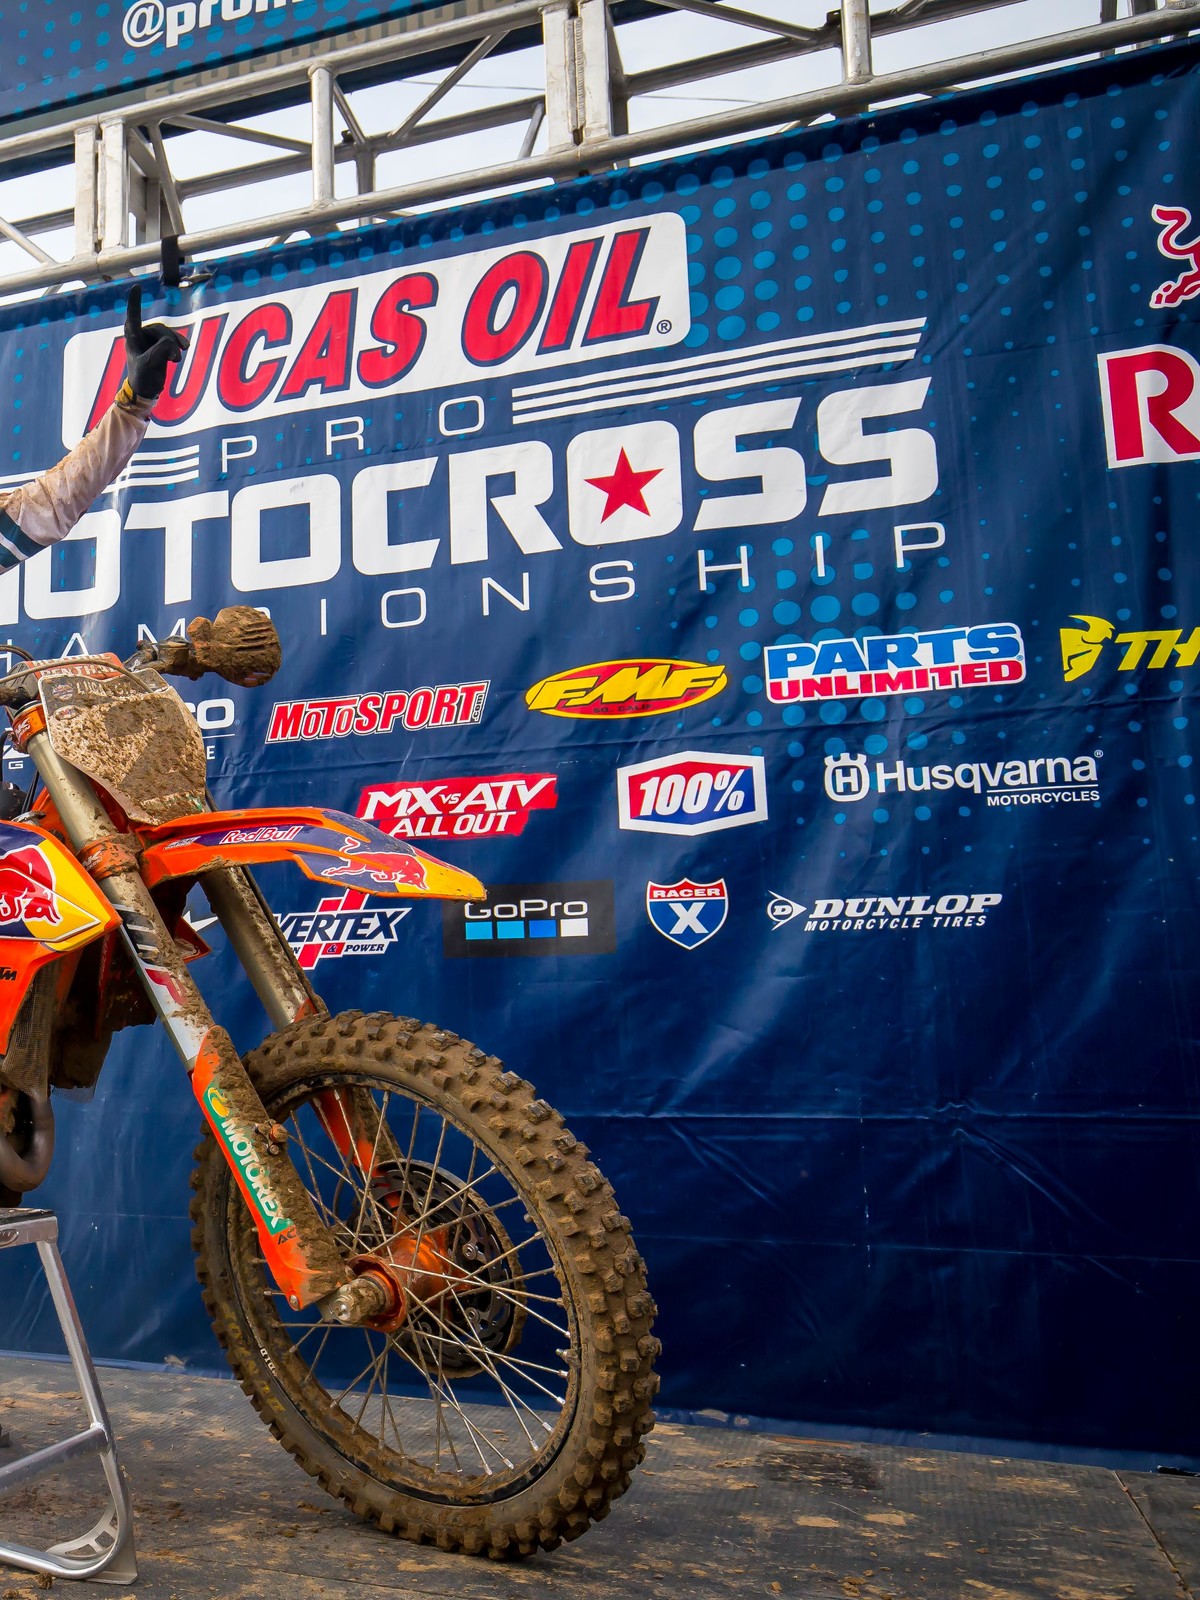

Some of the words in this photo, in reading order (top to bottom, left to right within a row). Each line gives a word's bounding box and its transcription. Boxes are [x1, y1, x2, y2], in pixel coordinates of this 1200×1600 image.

[122, 0, 305, 48] @pro
[460, 227, 664, 368] OIL
[221, 394, 486, 474] PRO
[766, 623, 1023, 680] PARTS
[528, 664, 725, 711] FMF
[768, 660, 1024, 703] UNLIMITED
[877, 752, 1098, 794] Husqvarna
[360, 785, 449, 820] MX
[439, 793, 462, 804] vs
[449, 777, 557, 814] ATV
[639, 769, 745, 816] 100%
[987, 790, 1100, 807] MOTORCYCLES
[220, 829, 260, 844] Red
[256, 825, 304, 842] Bull
[388, 815, 448, 838] ALL
[453, 811, 516, 835] OUT
[464, 899, 588, 919] GoPro
[651, 887, 722, 899] RACER
[808, 893, 1003, 918] DUNLOP
[274, 909, 412, 943] VERTEX
[668, 902, 710, 935] X
[804, 917, 922, 932] MOTORCYCLE
[932, 915, 988, 928] TIRES
[344, 943, 385, 952] POWER
[221, 1118, 290, 1229] MOTOREX
